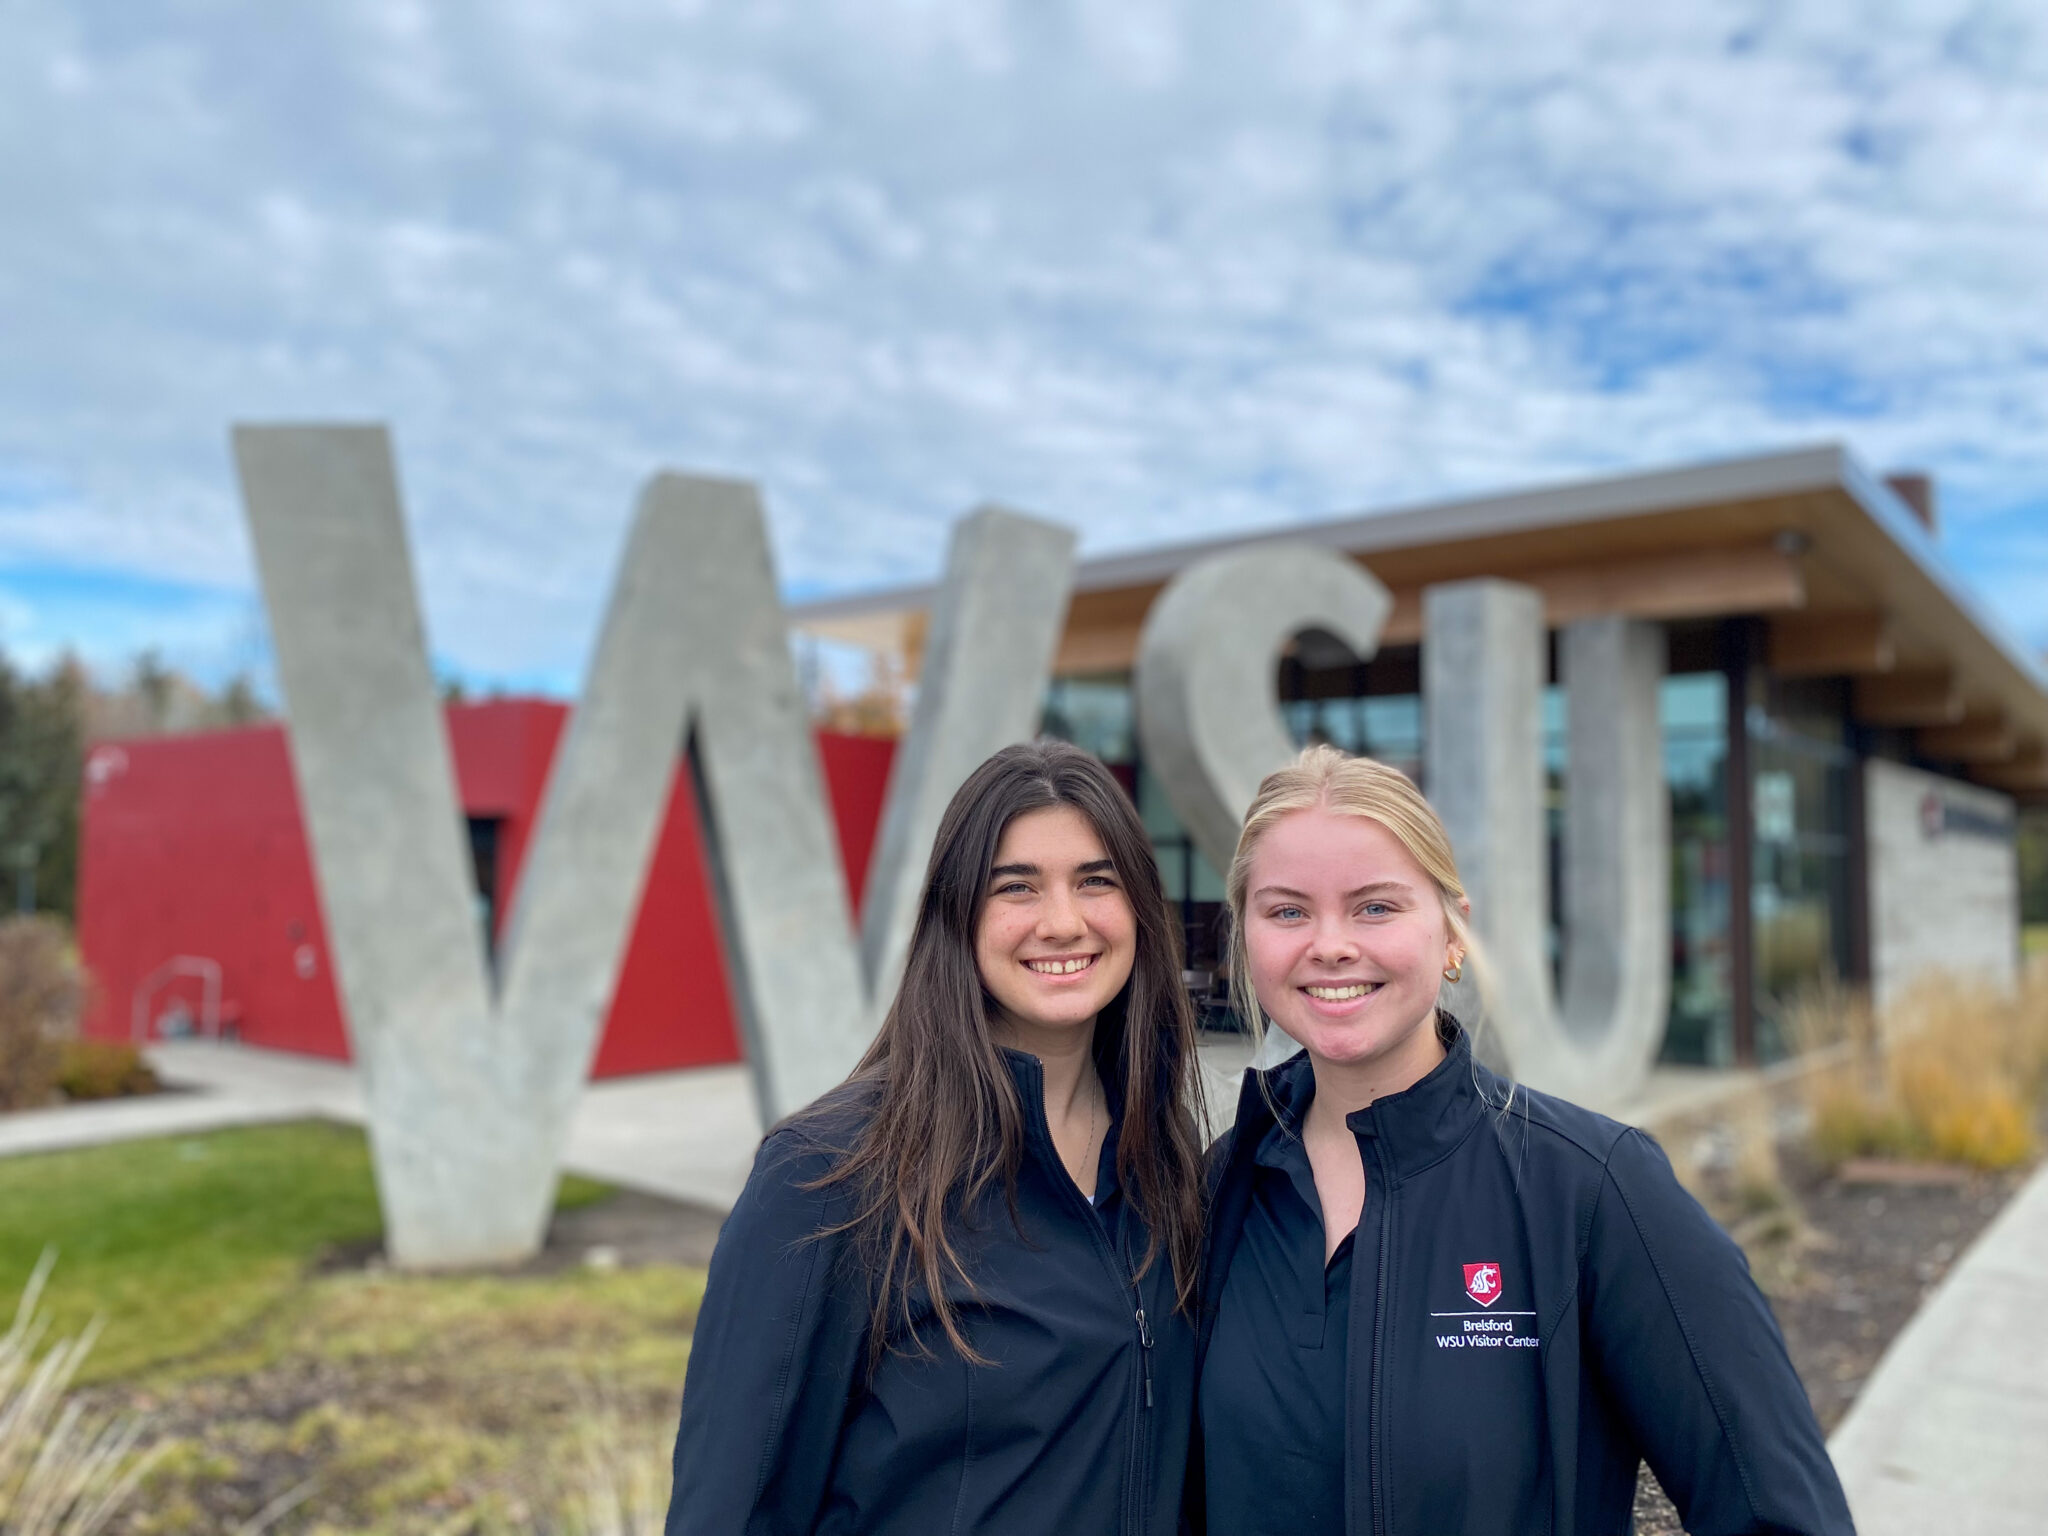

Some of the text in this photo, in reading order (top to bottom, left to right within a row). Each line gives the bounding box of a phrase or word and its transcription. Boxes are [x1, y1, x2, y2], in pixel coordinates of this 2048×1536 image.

[1463, 1319, 1513, 1332] Brelsford
[1436, 1334, 1540, 1348] WSU Visitor Center
